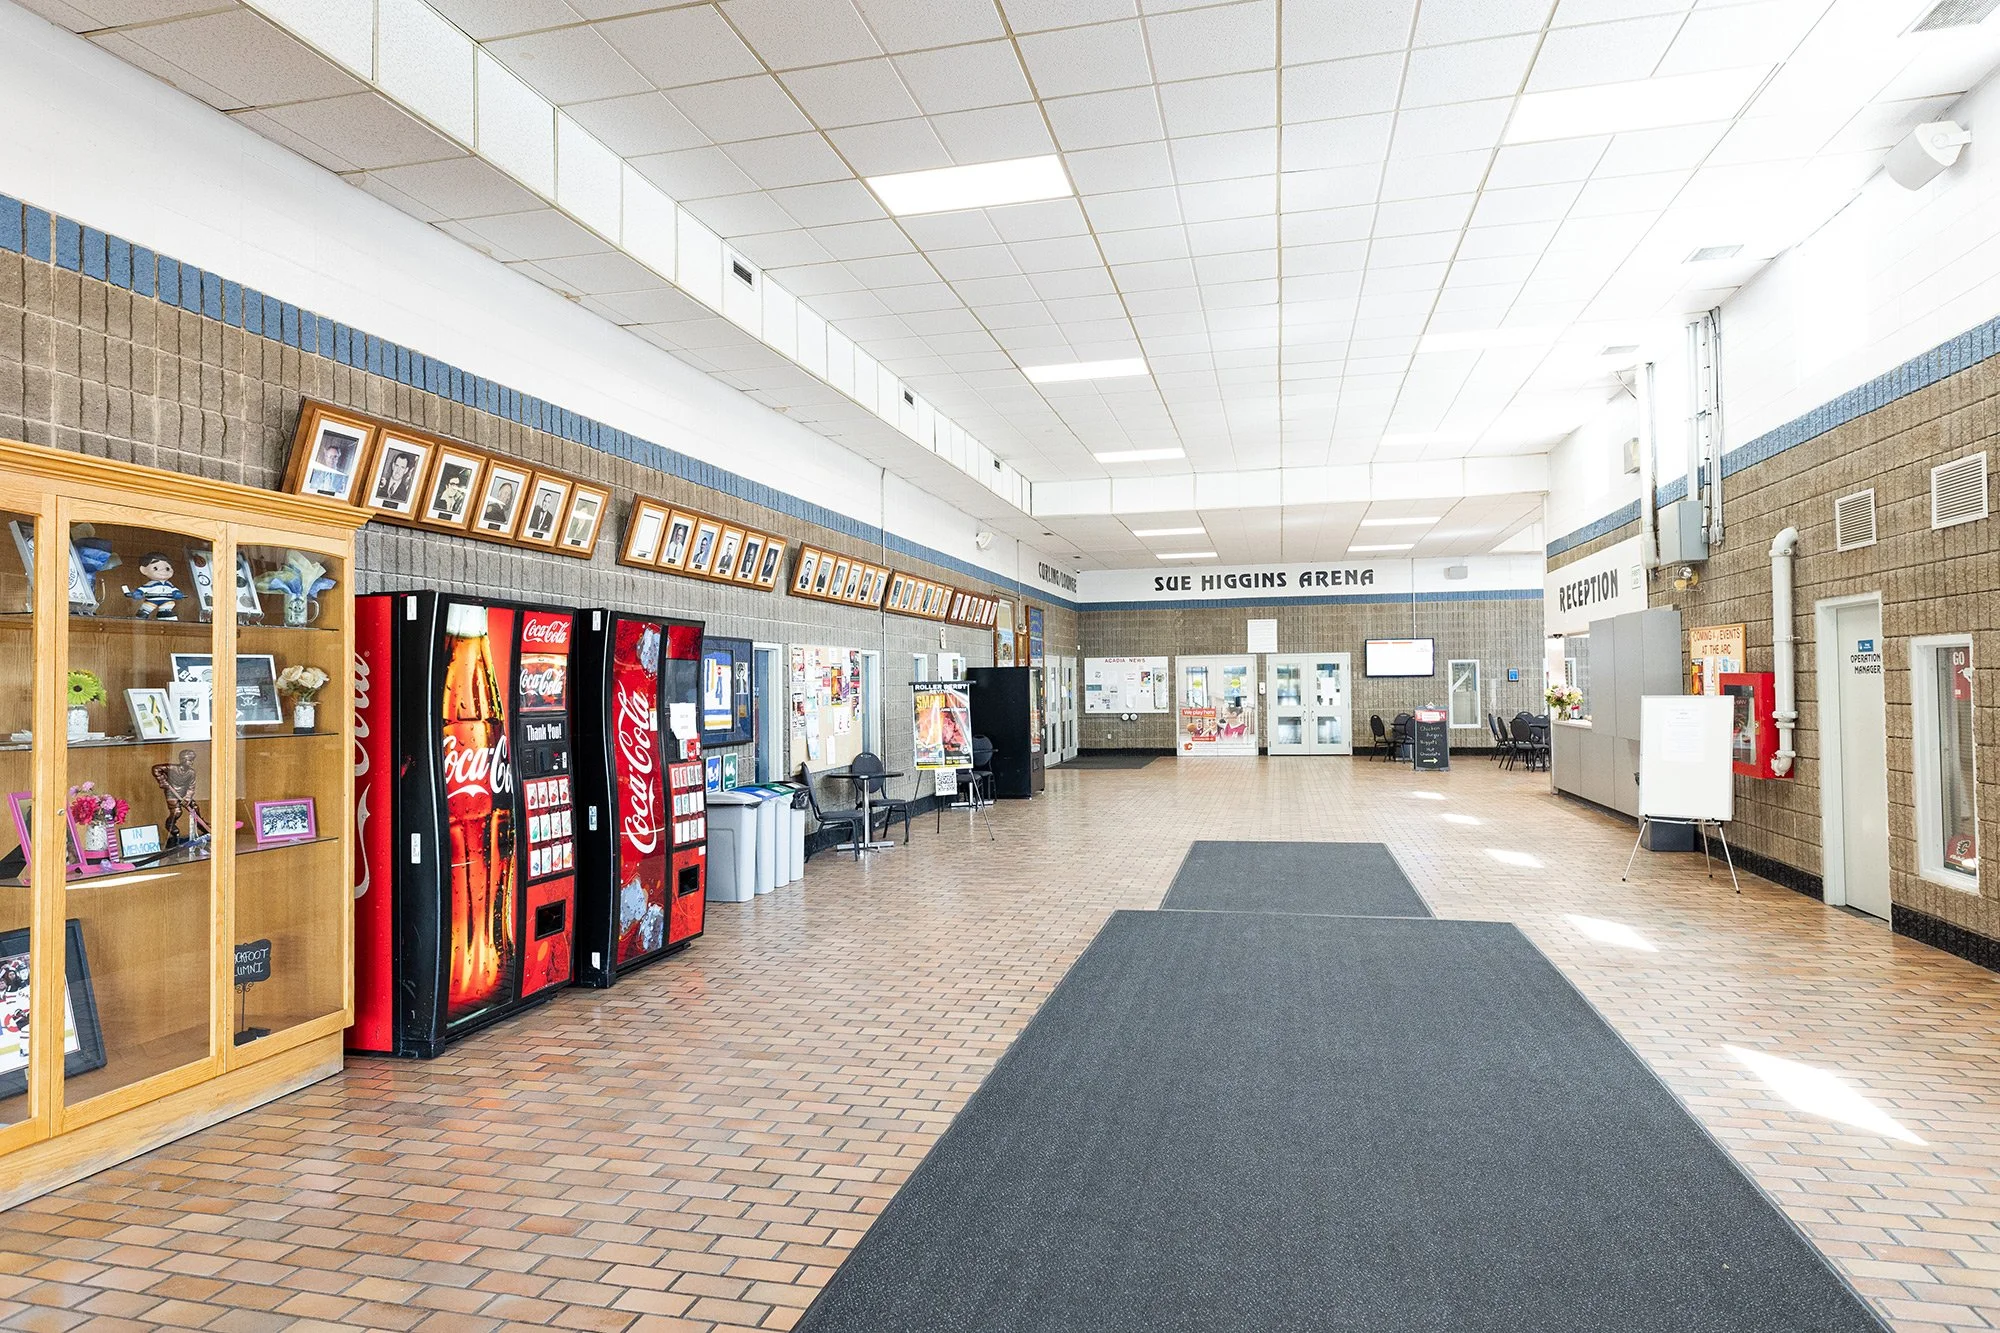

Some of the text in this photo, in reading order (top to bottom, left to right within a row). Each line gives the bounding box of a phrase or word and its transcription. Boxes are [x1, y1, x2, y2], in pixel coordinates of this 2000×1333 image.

[1155, 569, 1374, 592] SUE HIGGINS ARENA
[1560, 568, 1618, 613] RECEPTION
[523, 619, 570, 644] Coca-Cola
[1720, 628, 1740, 639] EVENTS
[1850, 653, 1881, 663] OPERATION
[1953, 651, 1964, 665] GO
[1854, 665, 1881, 674] MANAGER
[520, 668, 565, 696] Coca-Cola
[526, 722, 562, 742] Thank You!
[618, 680, 657, 854] Coca-Cola
[132, 828, 143, 840] IN
